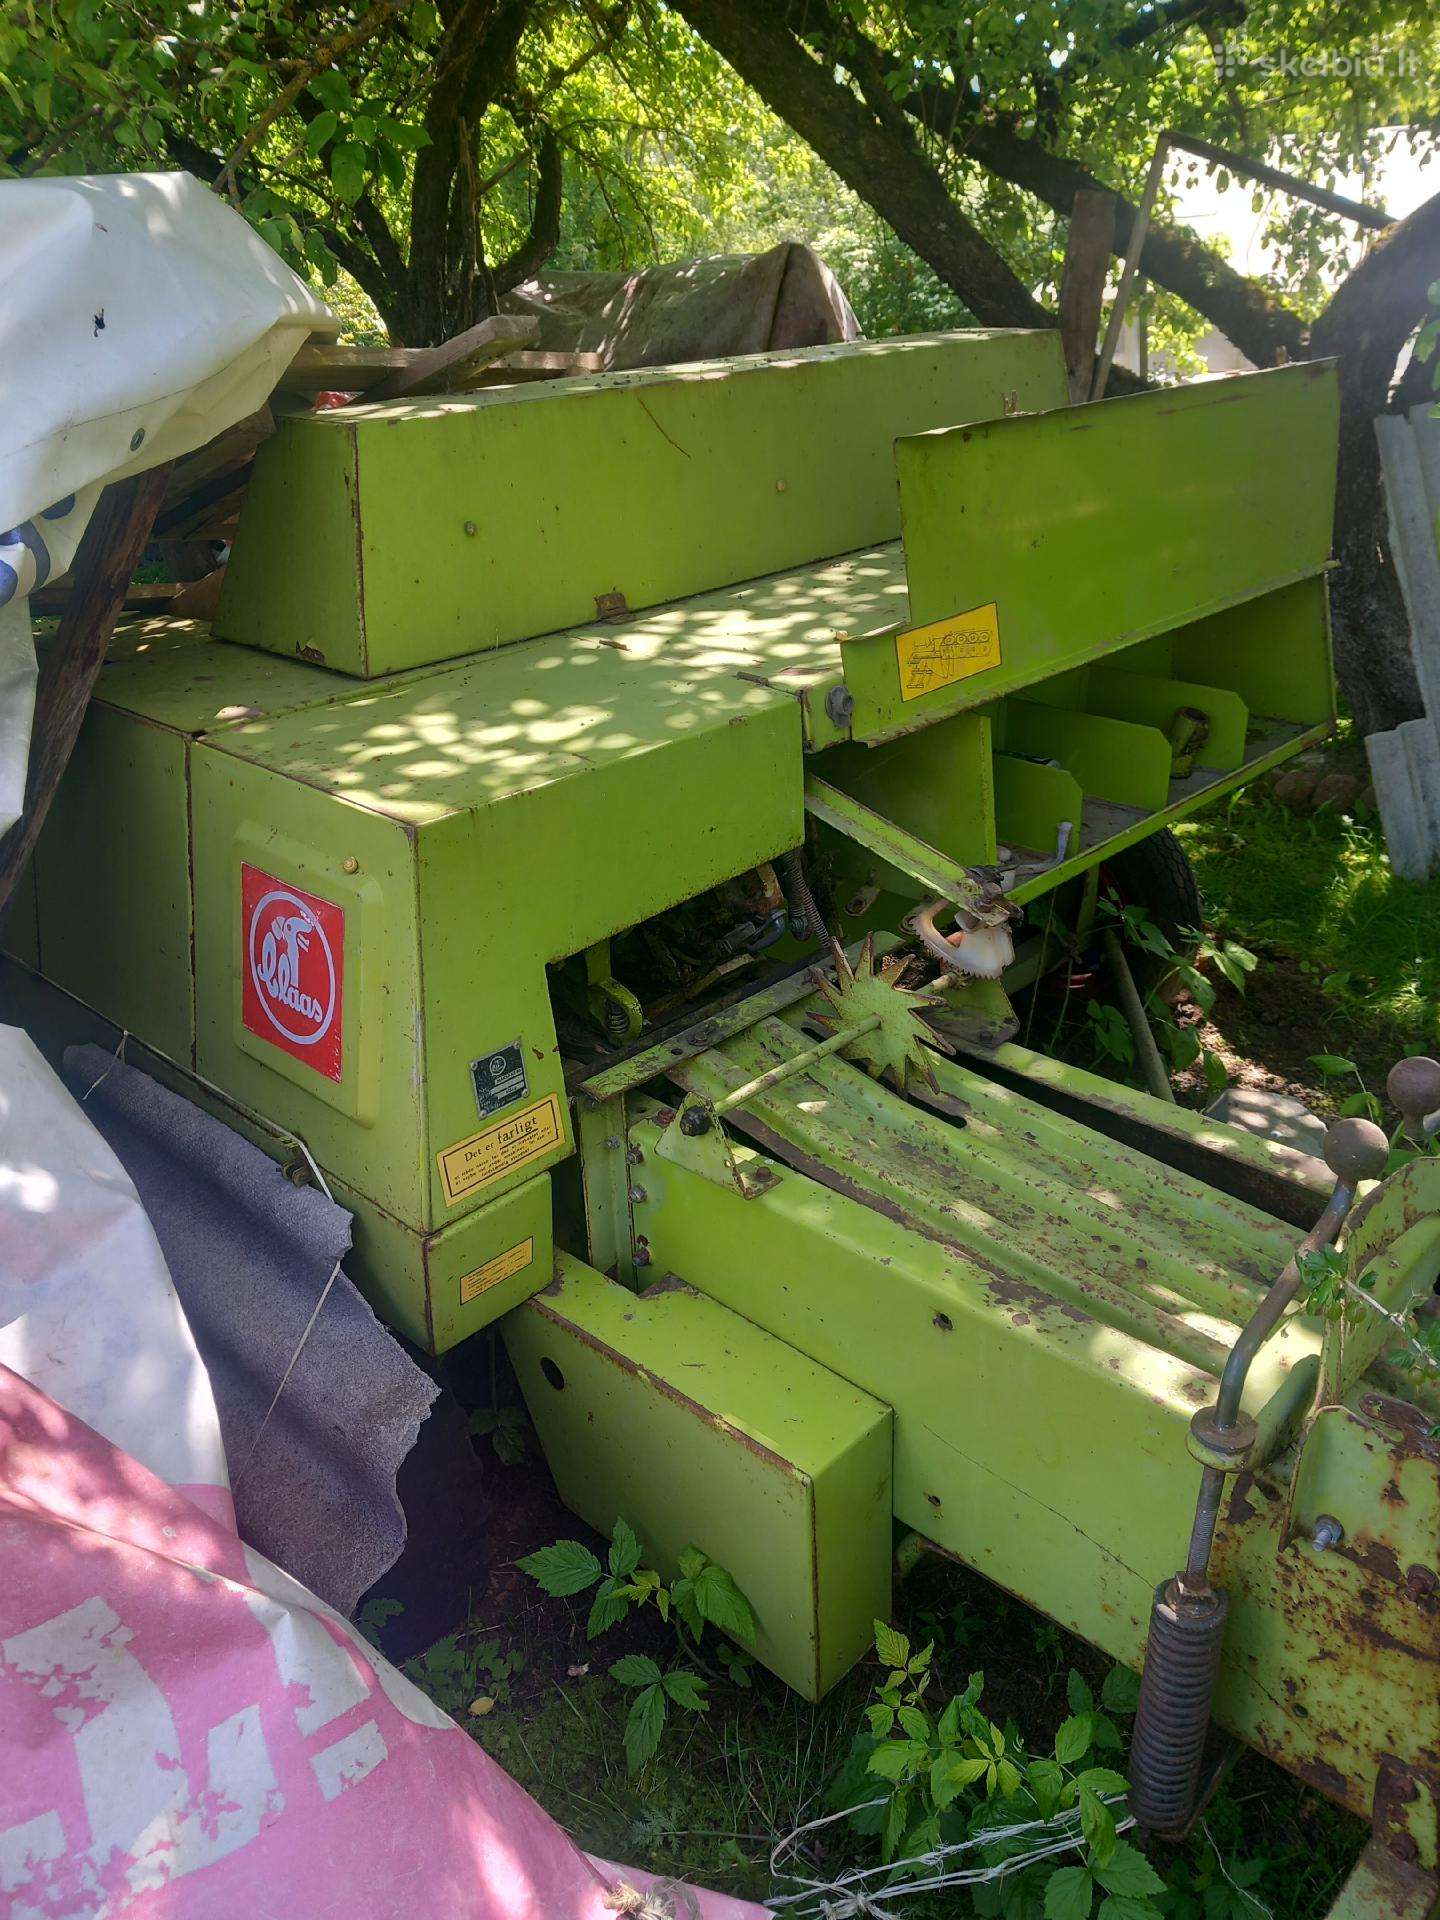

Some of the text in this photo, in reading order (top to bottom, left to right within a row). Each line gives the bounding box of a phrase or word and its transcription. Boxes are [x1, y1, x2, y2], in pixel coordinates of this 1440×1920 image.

[464, 1116, 537, 1162] Det er farligt
